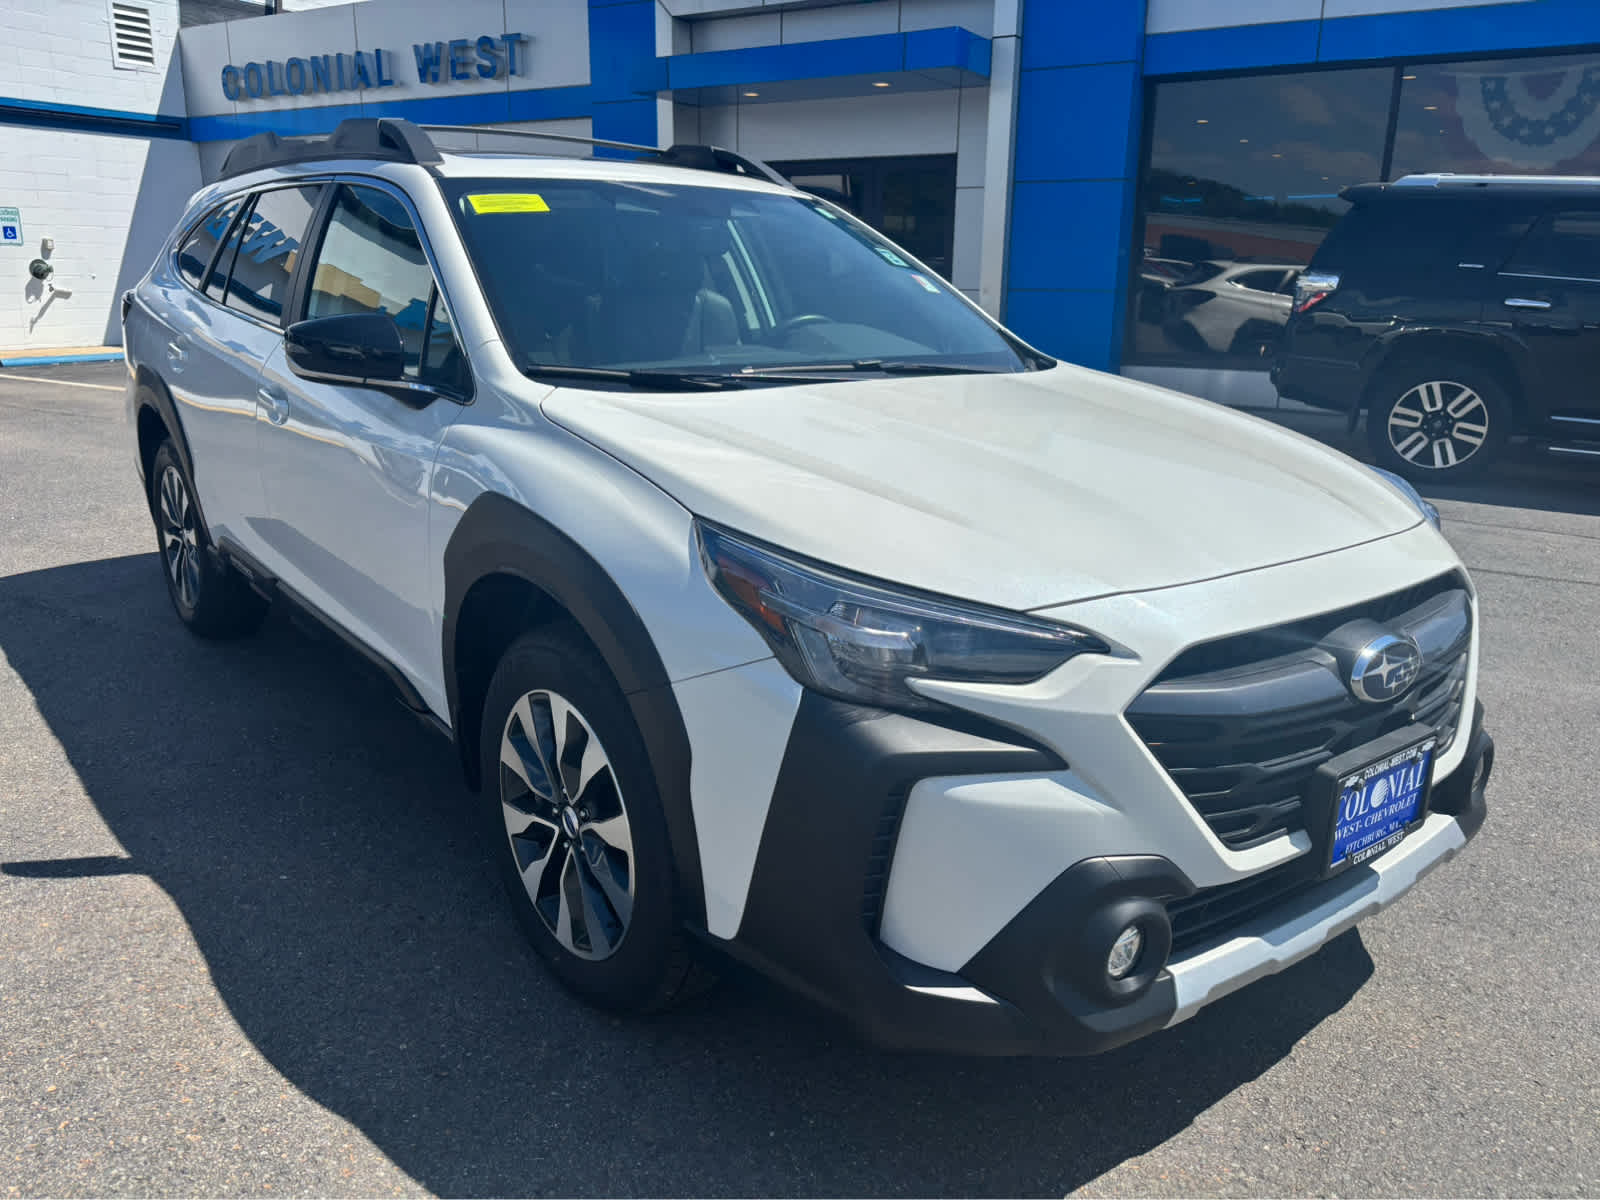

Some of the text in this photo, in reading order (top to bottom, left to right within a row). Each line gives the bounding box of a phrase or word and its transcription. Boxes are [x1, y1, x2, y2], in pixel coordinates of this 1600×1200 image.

[221, 32, 523, 101] COLONIAL WEST
[1364, 792, 1417, 828] CHEVROLET
[1353, 830, 1405, 865] COLONIAL WEST
